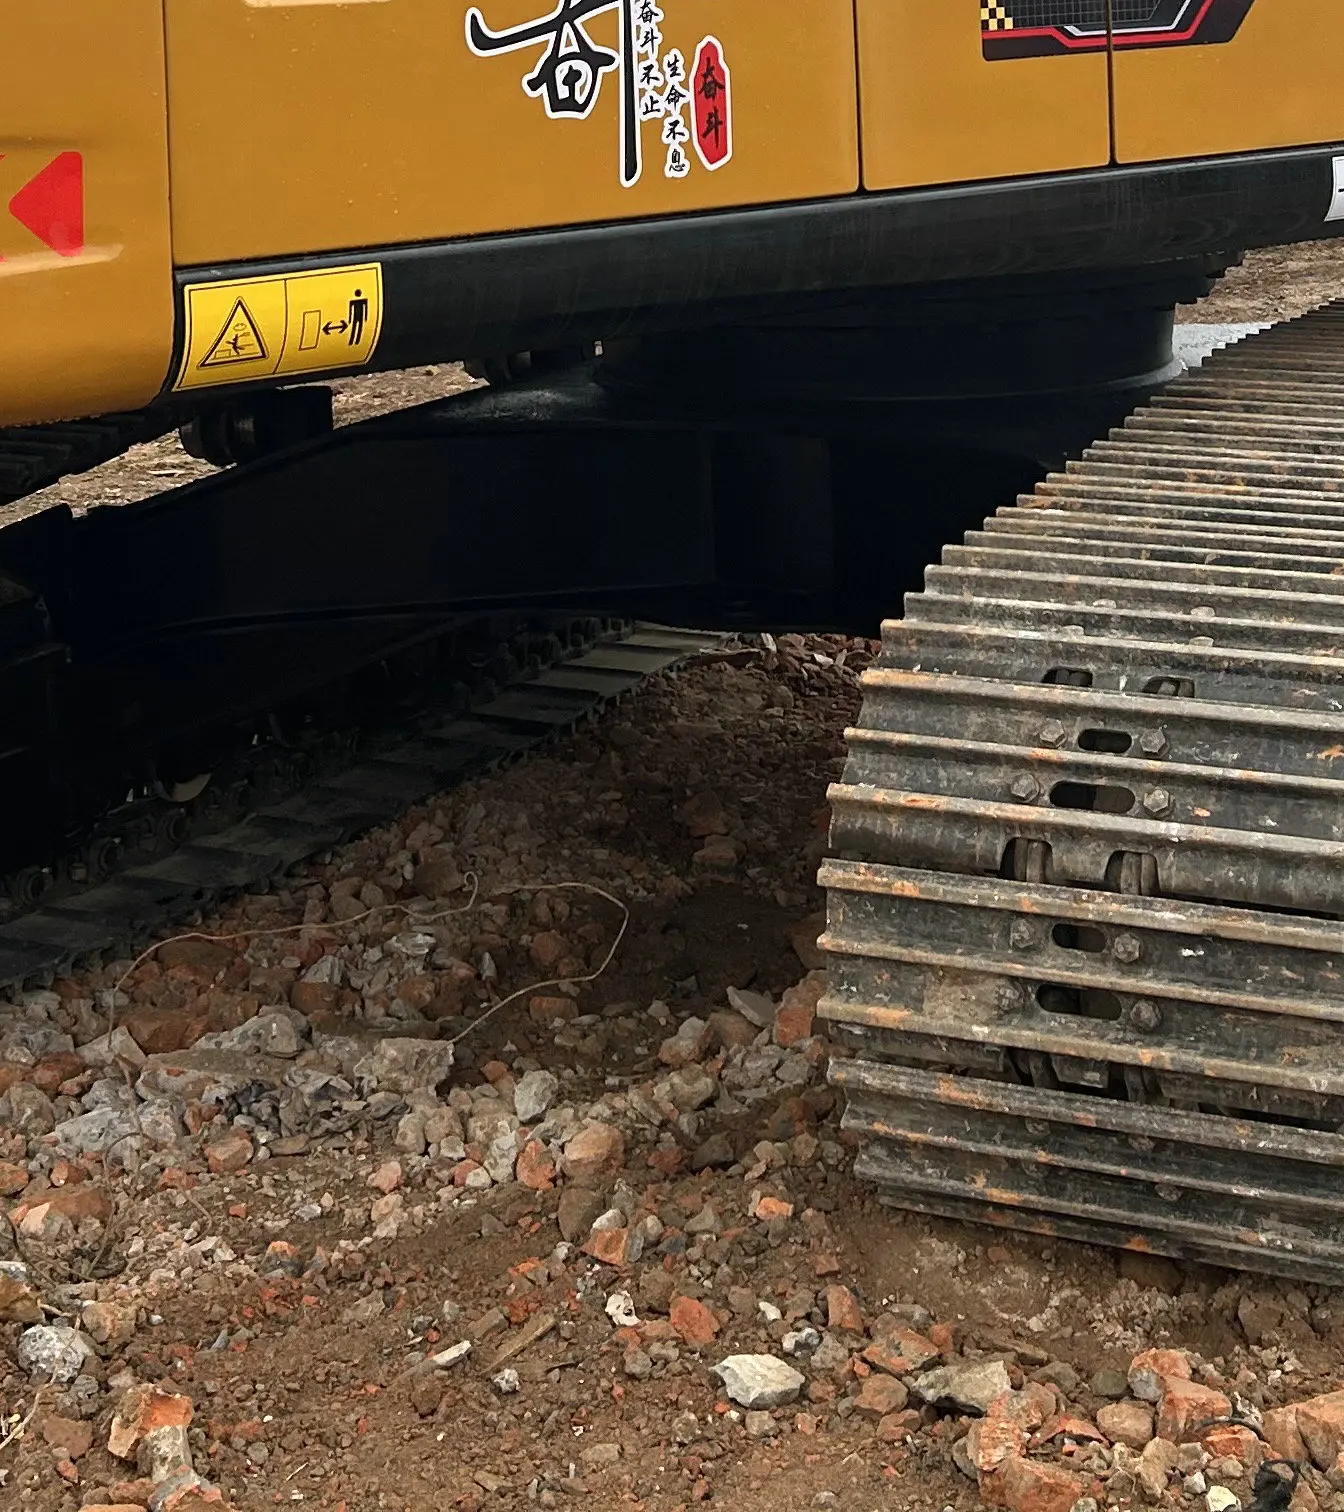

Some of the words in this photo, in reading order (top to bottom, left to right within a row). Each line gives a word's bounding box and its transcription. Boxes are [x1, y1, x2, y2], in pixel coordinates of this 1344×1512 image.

[664, 53, 688, 173] 生命不息
[697, 56, 726, 150] 奋斗
